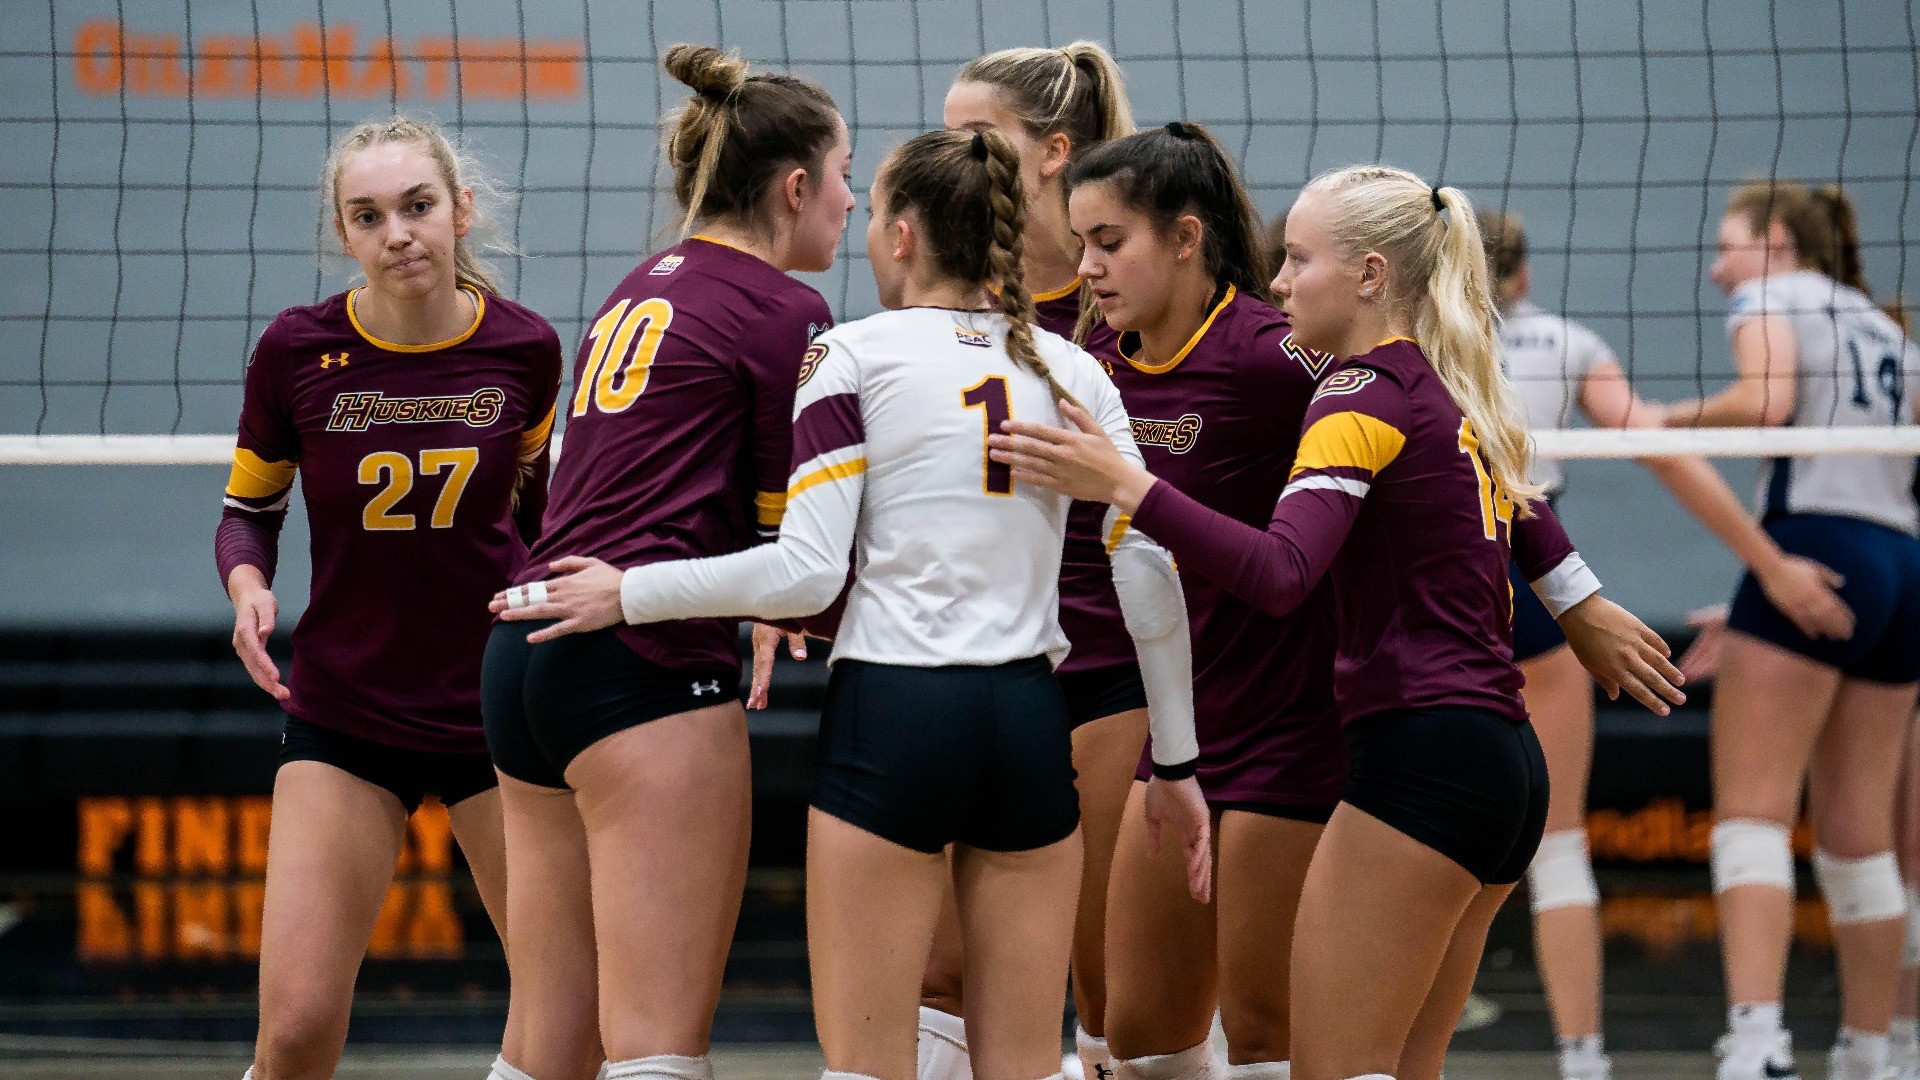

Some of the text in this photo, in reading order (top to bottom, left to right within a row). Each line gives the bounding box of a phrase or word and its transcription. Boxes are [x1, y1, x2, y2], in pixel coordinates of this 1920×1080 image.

[573, 298, 674, 417] 10
[955, 331, 991, 344] PSAC
[326, 387, 505, 431] HUSKIES
[1846, 334, 1902, 426] 19
[960, 374, 1015, 497] 1
[1128, 413, 1203, 455] SKIES
[357, 447, 479, 531] 27
